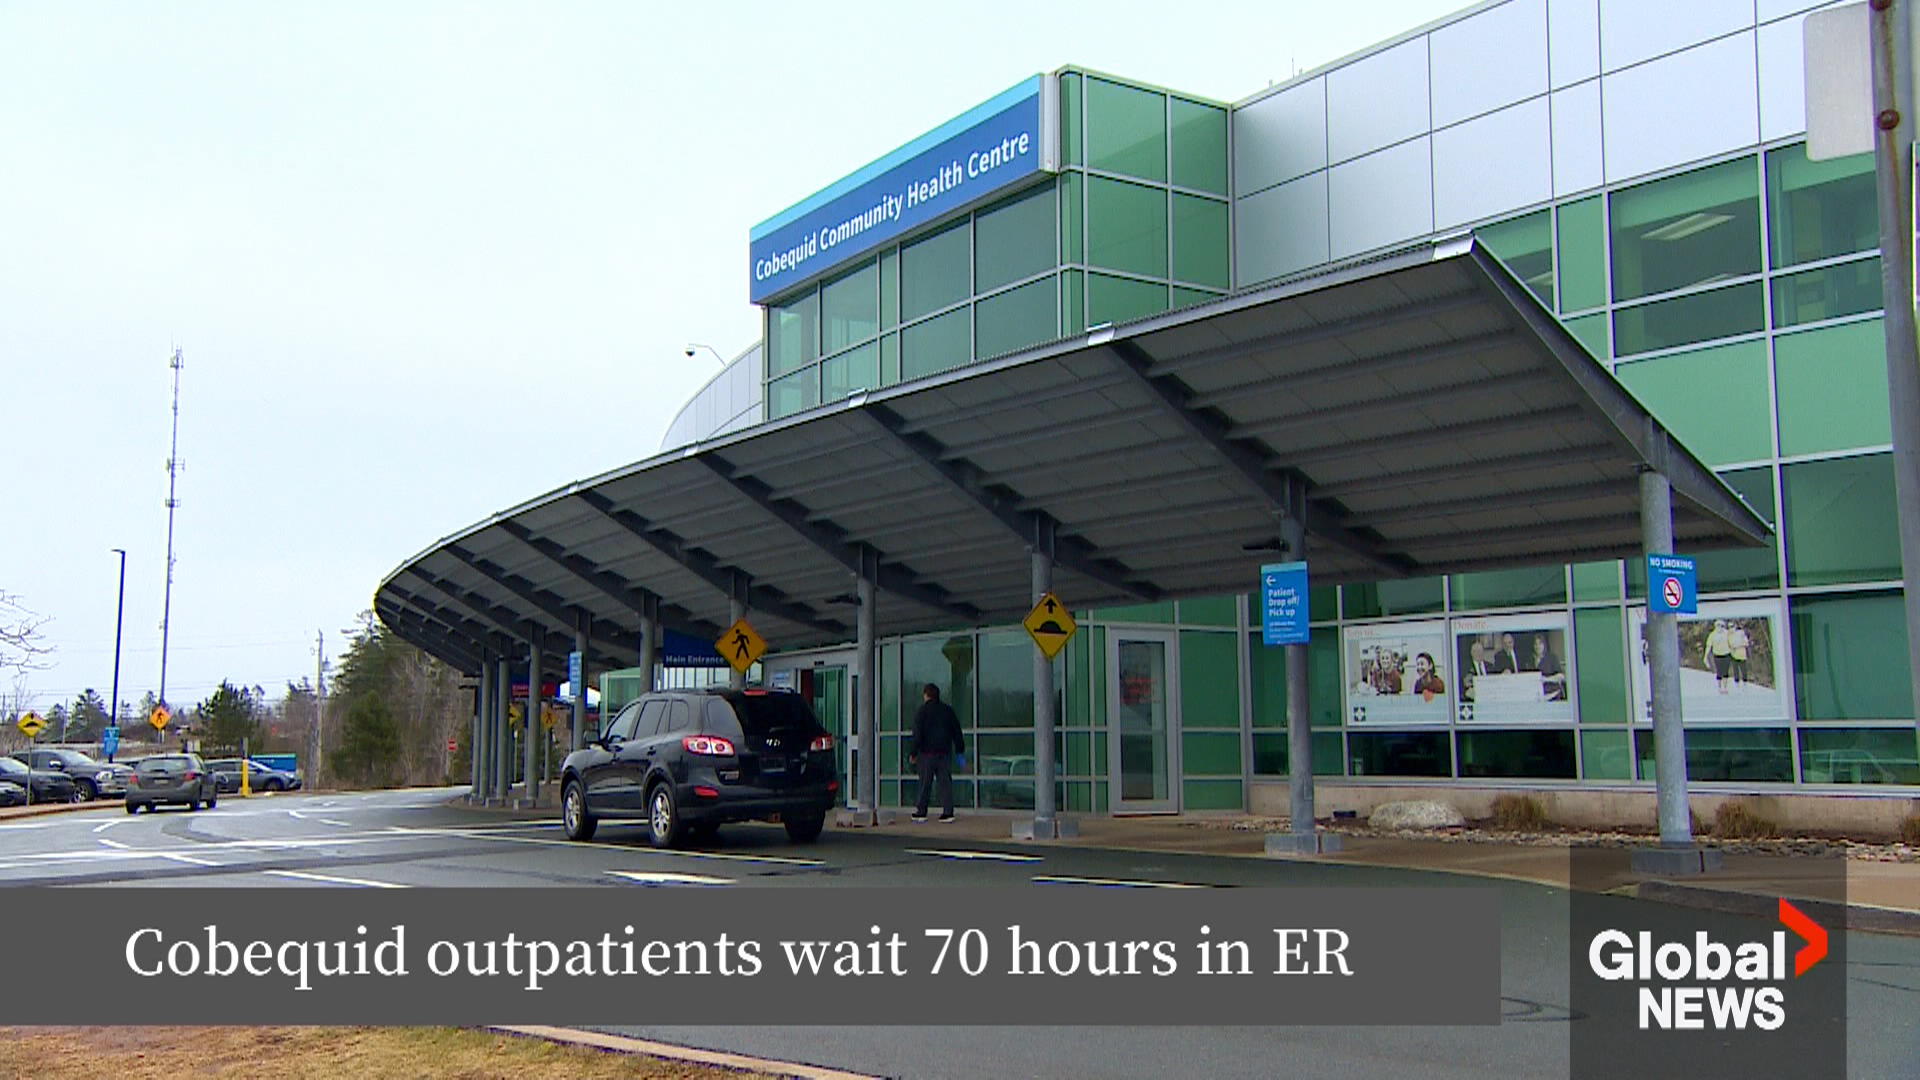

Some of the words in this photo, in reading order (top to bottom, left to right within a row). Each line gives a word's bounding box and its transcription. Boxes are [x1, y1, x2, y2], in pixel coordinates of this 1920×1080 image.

[756, 231, 817, 281] Cobequid
[820, 193, 903, 250] Community
[907, 160, 963, 208] Health
[967, 132, 1029, 179] Centre
[1649, 557, 1660, 567] NO
[1661, 558, 1693, 570] SMOKING
[1268, 588, 1295, 597] Patient
[1268, 598, 1286, 608] Drop
[1286, 609, 1296, 617] up
[666, 655, 686, 664] Main
[688, 655, 724, 664] Entrance
